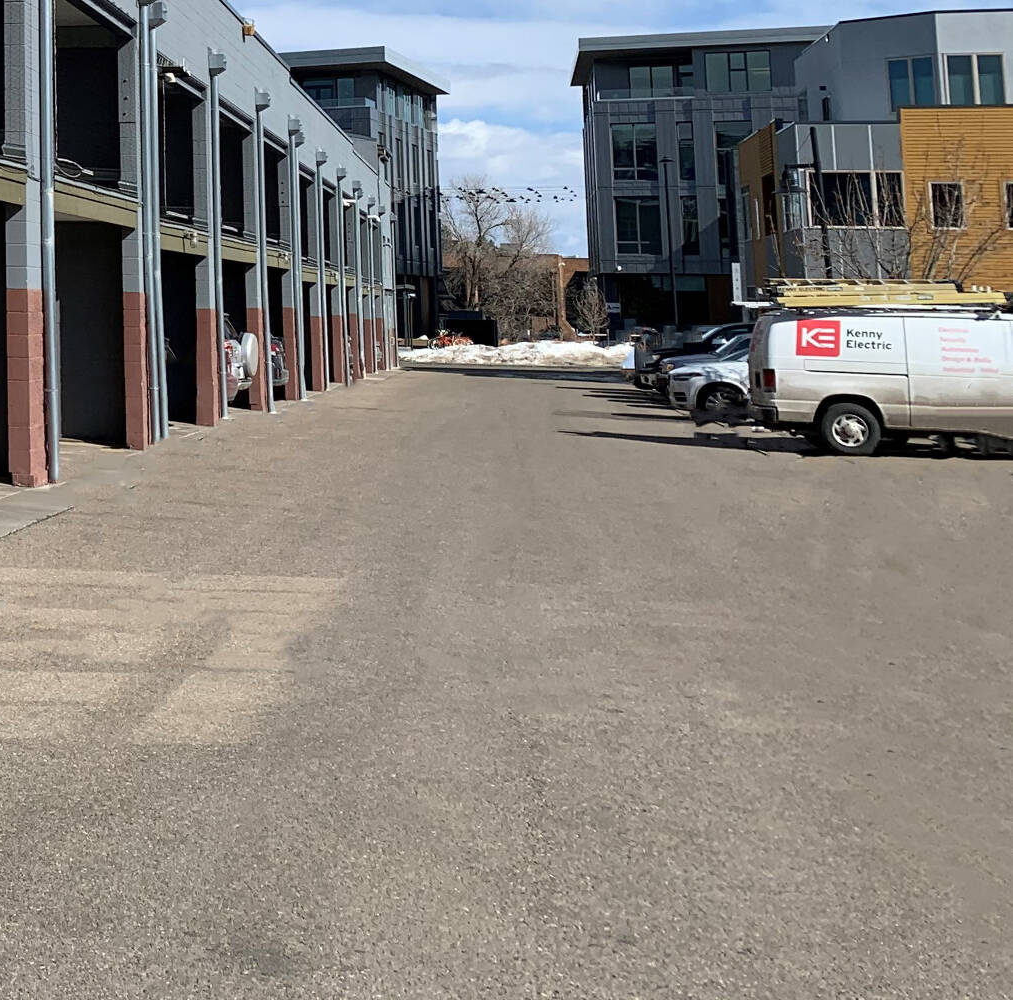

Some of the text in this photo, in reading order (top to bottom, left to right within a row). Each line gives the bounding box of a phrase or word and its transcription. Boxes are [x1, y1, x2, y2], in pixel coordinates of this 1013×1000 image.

[801, 327, 835, 349] KE
[846, 328, 883, 340] Kenny
[846, 340, 892, 350] Electric
